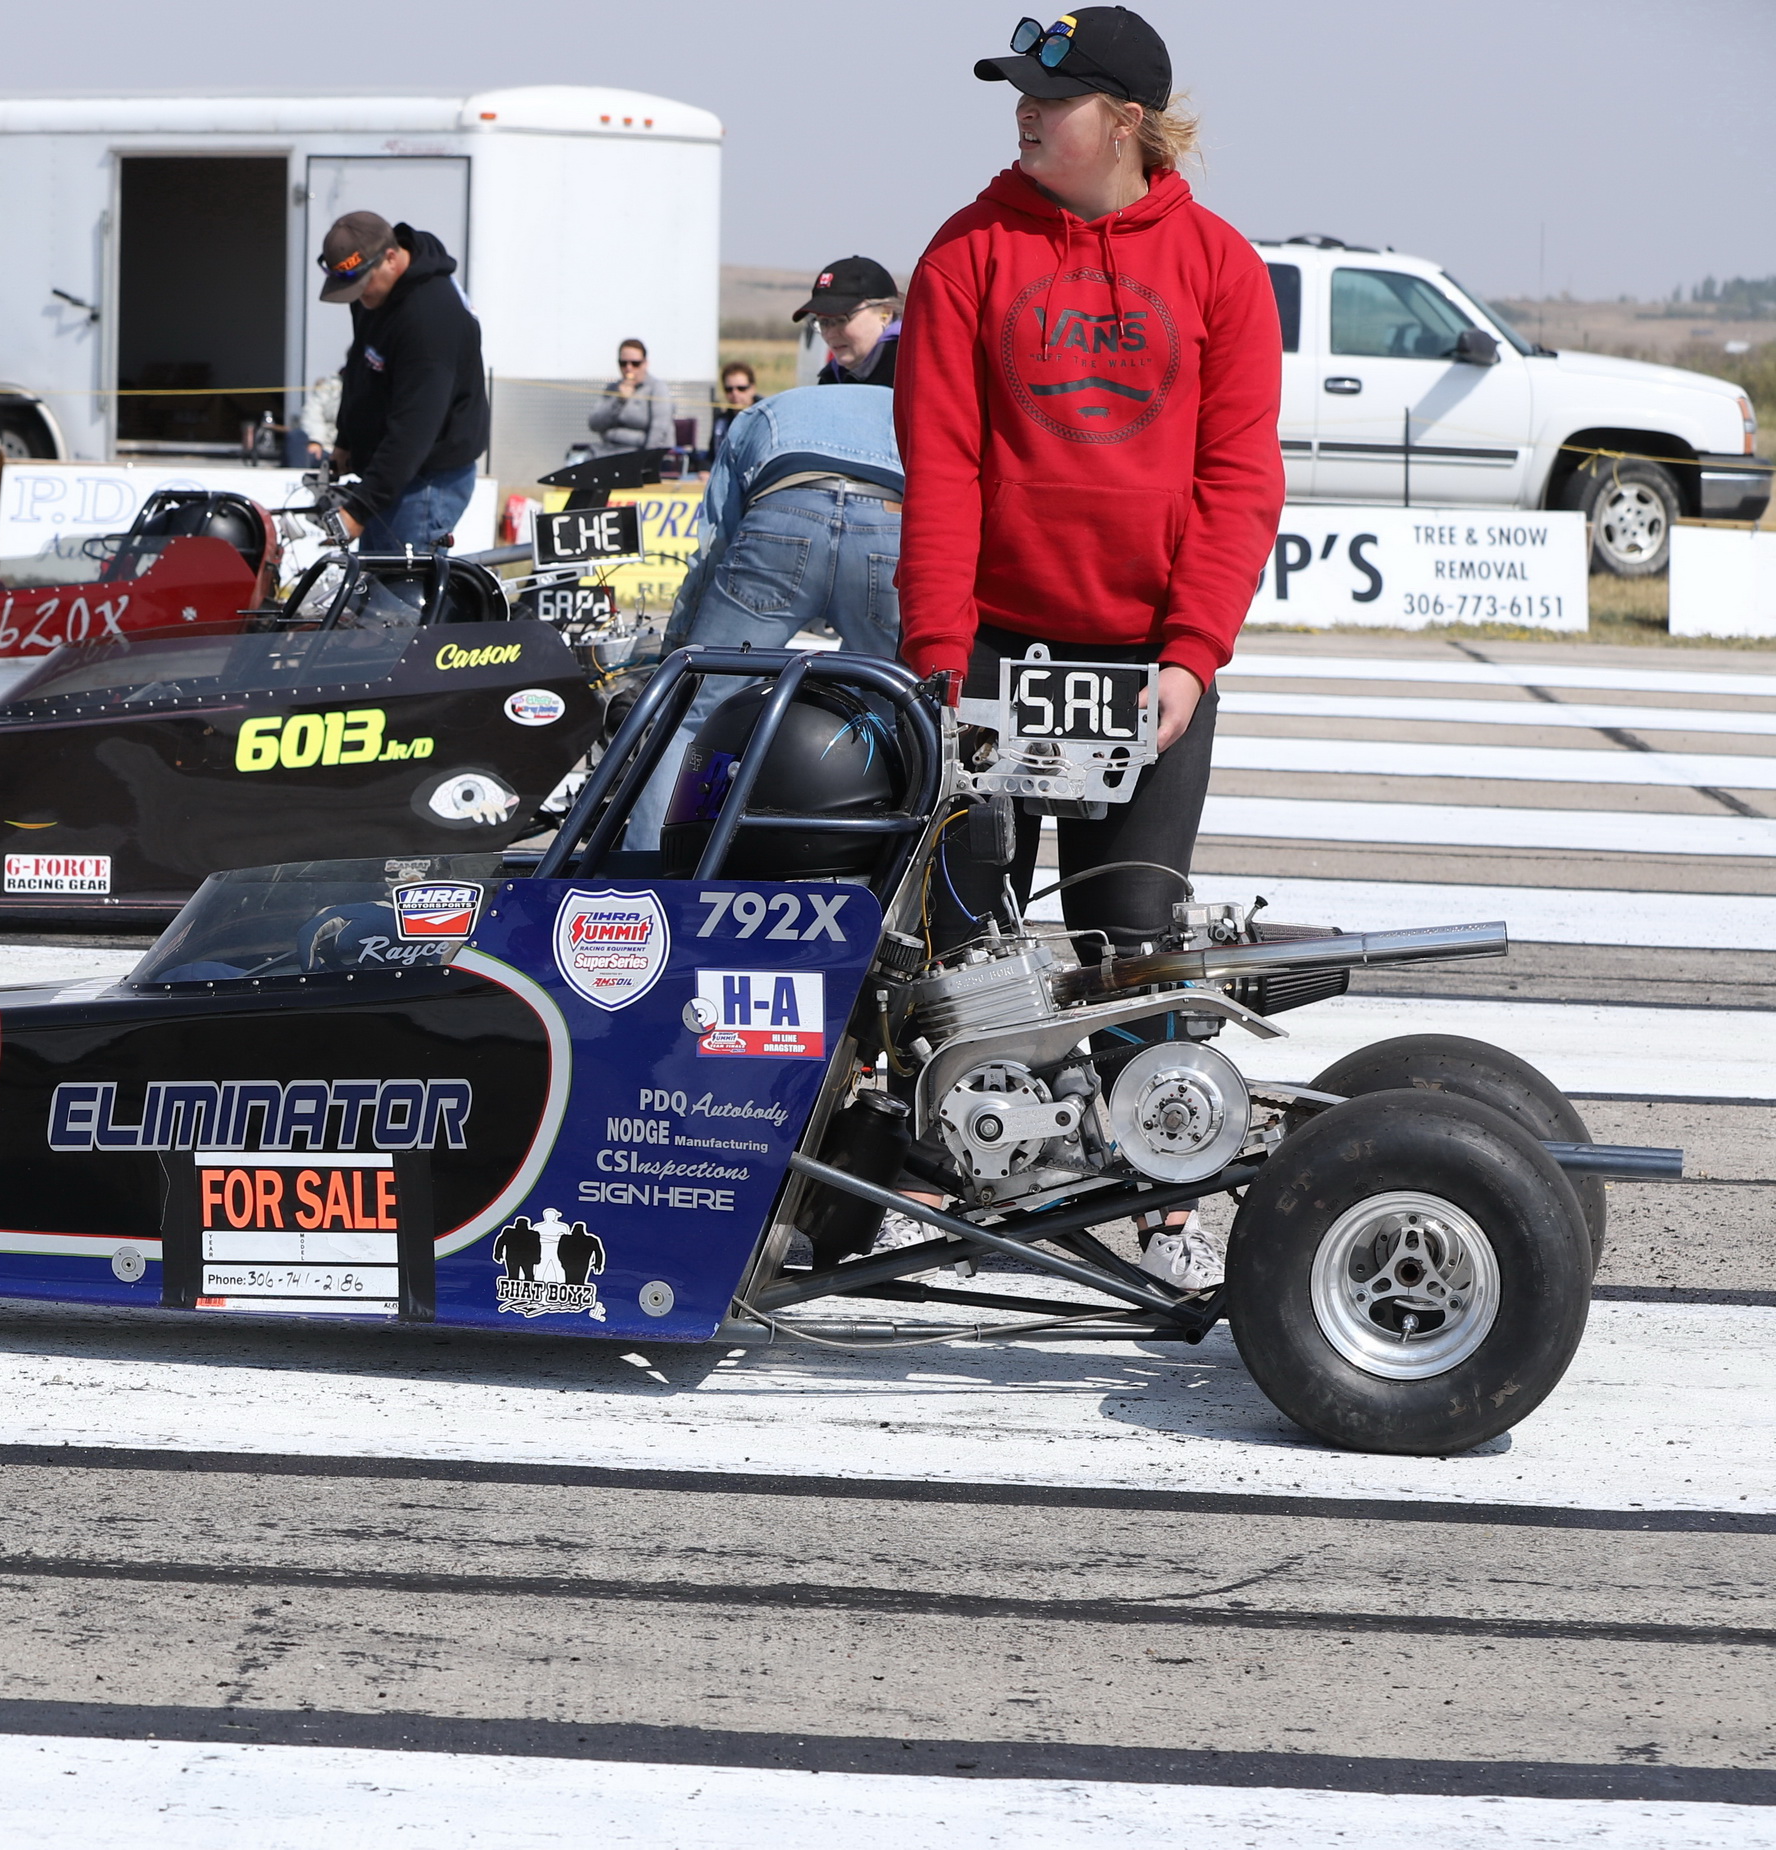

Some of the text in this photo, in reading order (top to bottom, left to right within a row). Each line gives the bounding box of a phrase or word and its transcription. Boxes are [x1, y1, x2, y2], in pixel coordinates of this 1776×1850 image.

[1033, 307, 1148, 354] VANS
[1414, 525, 1548, 547] TREE & SNOW
[1255, 533, 1384, 603] P'S
[1435, 561, 1529, 581] REMOVAL
[1404, 593, 1563, 617] 306-773-6151
[434, 643, 522, 671] Carson
[235, 707, 387, 773] 6013
[6, 857, 108, 877] G-FORCE
[7, 878, 108, 891] RACING GEAR
[403, 889, 472, 904] IHRA
[402, 902, 472, 910] MOTORSPORTS
[593, 912, 641, 921] IHRA
[696, 891, 851, 942] 792X
[357, 935, 453, 965] Rayce
[574, 953, 649, 972] SuperSeries
[592, 978, 633, 988] AMSOIL
[722, 975, 801, 1027] H-A
[763, 1043, 806, 1053] DRAGSTRIP
[771, 1033, 798, 1043] HI LINE
[47, 1078, 473, 1152] ELIMINATOR
[639, 1088, 789, 1127] PDQ Autobody
[606, 1117, 769, 1154] NODGE Manufacturing
[200, 1168, 399, 1230] FOR SALE
[578, 1181, 735, 1211] SIGN HERE
[208, 1274, 246, 1286] Phone:
[499, 1280, 592, 1304] PHAT BOYZ
